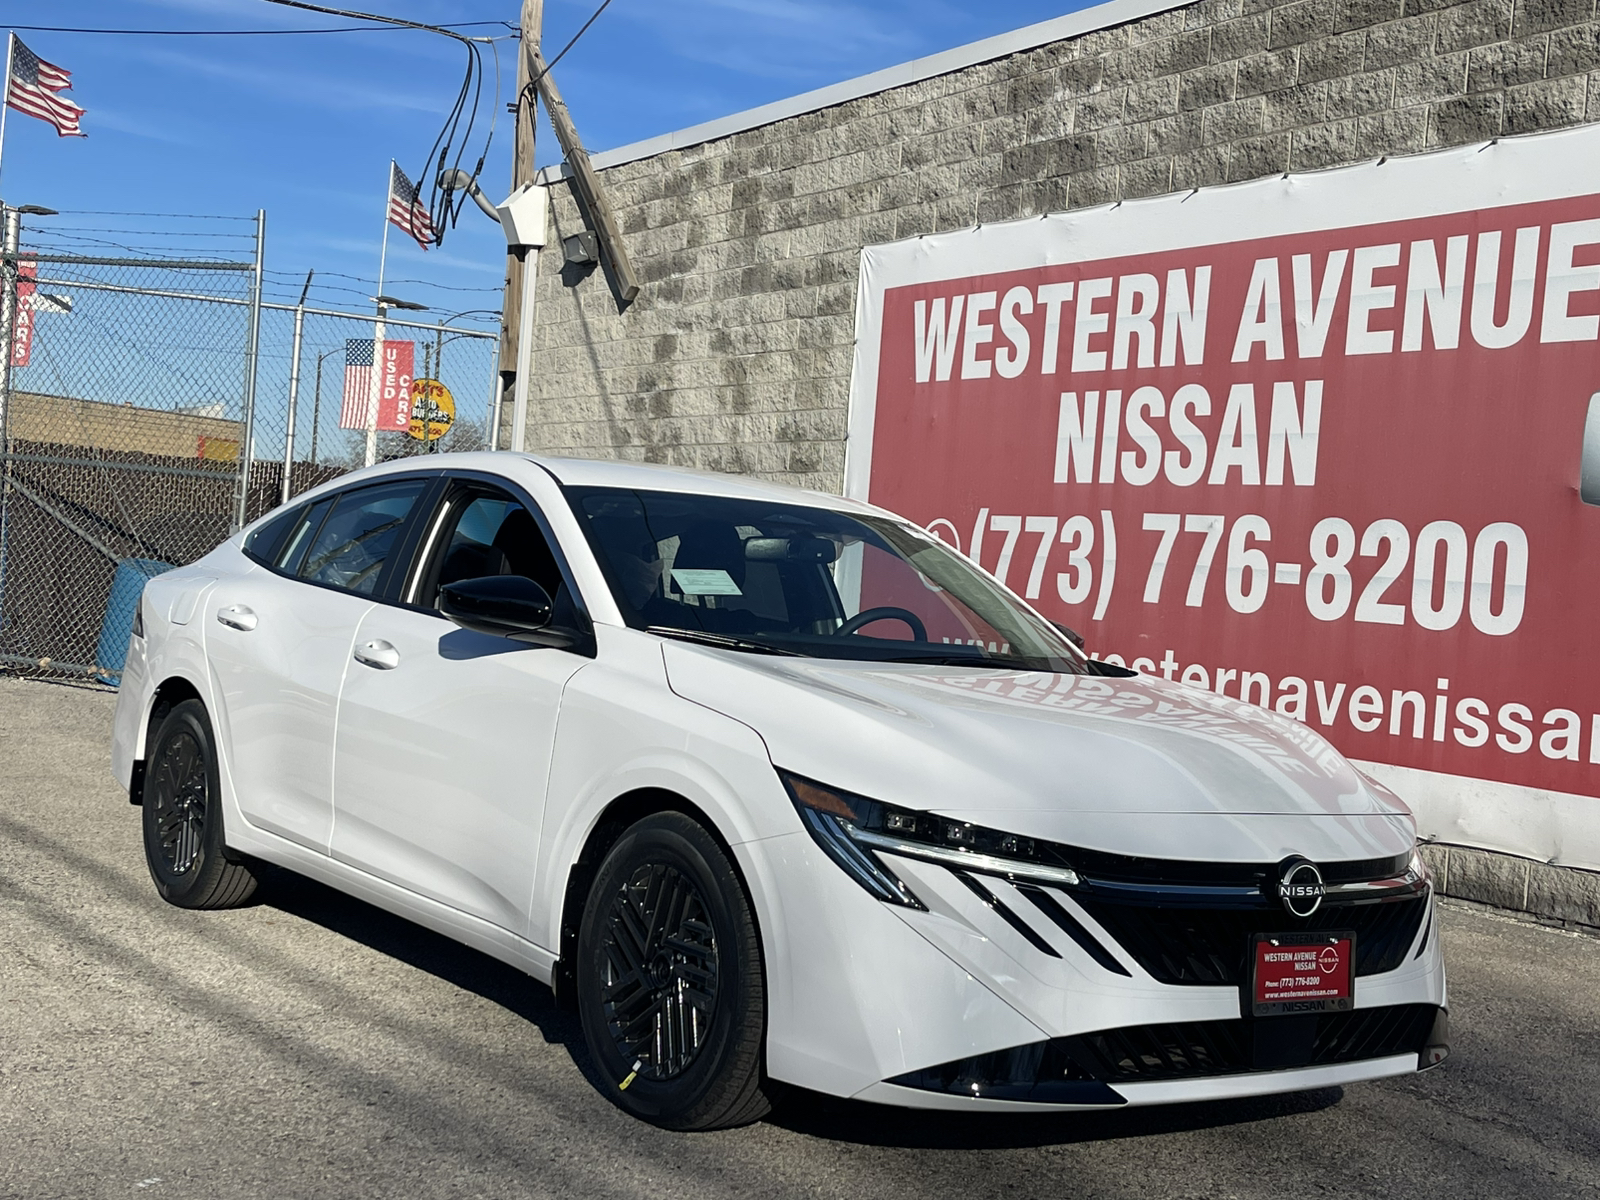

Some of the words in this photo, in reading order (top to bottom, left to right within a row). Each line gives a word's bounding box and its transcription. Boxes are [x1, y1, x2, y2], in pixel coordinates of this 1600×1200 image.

[914, 265, 1212, 383] WESTERN
[1231, 217, 1600, 364] AVENUE
[383, 348, 397, 400] USED
[395, 375, 411, 425] CARS
[1053, 380, 1325, 487] NISSAN
[970, 508, 1117, 621] (773)
[1142, 513, 1529, 636] 776-8200
[1280, 886, 1326, 896] NISSAN
[1264, 953, 1293, 962] WESTERN
[1294, 952, 1317, 961] AVENUE
[1295, 961, 1316, 971] NISSAN
[1280, 977, 1294, 988] (773)
[1295, 976, 1320, 986] 776-8200
[1265, 989, 1338, 999] www.westernavenissan.com
[1282, 1000, 1326, 1012] NISSAN
